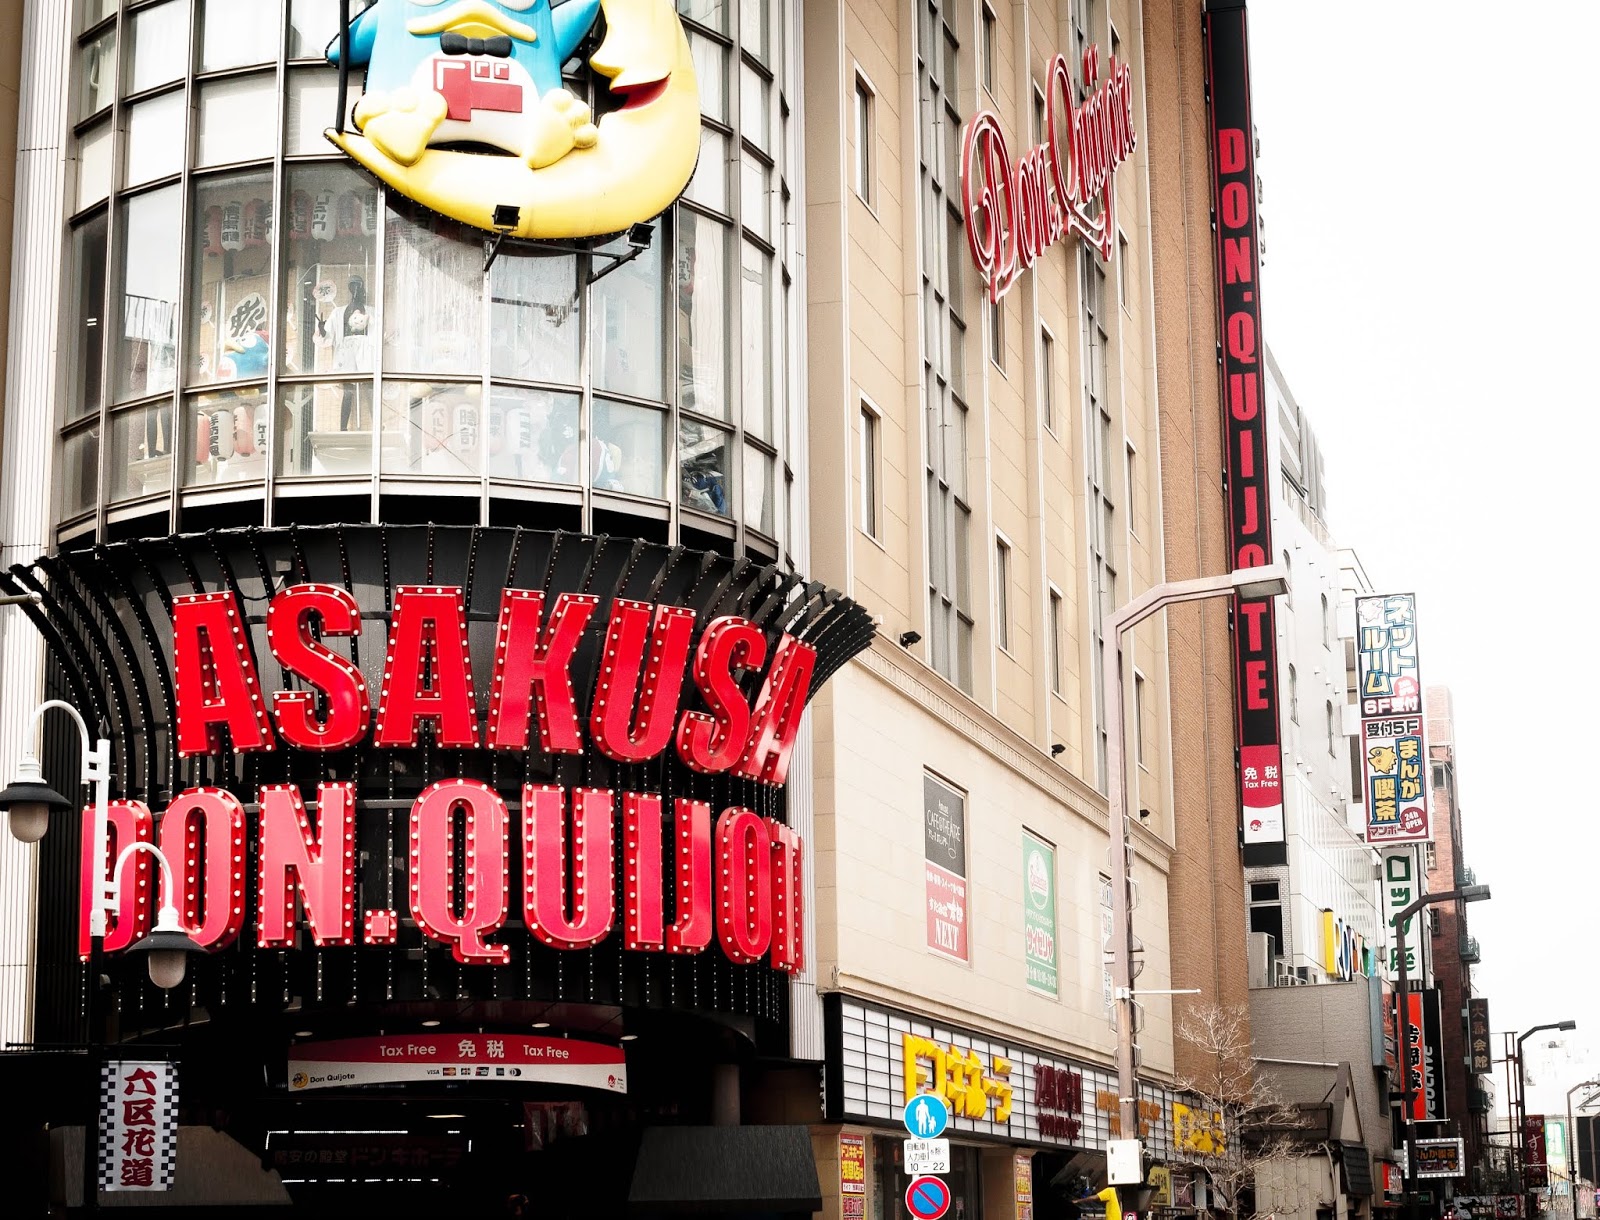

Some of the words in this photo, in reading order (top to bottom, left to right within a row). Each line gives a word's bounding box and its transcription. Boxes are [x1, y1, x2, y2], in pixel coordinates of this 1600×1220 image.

[1385, 597, 1415, 677] ネット
[1361, 626, 1393, 696] ルーム
[172, 583, 817, 787] ASAKUSA
[1367, 720, 1418, 737] 受付5F
[1244, 765, 1278, 780] 免税
[1397, 737, 1422, 801] まんが
[1373, 776, 1398, 822] 喫茶
[1404, 810, 1419, 821] 24h
[1405, 818, 1423, 830] OPEN
[1369, 825, 1406, 837] マンボー
[934, 919, 959, 952] NEXT
[380, 1045, 403, 1057] Tax
[407, 1044, 437, 1055] Free
[458, 1039, 505, 1059] 免税
[523, 1044, 544, 1057] Tax
[546, 1046, 570, 1059] Free
[310, 1075, 325, 1083] Don
[326, 1072, 355, 1083] Quijote
[120, 1067, 158, 1187] 六区花道
[906, 1142, 926, 1151] 自転車
